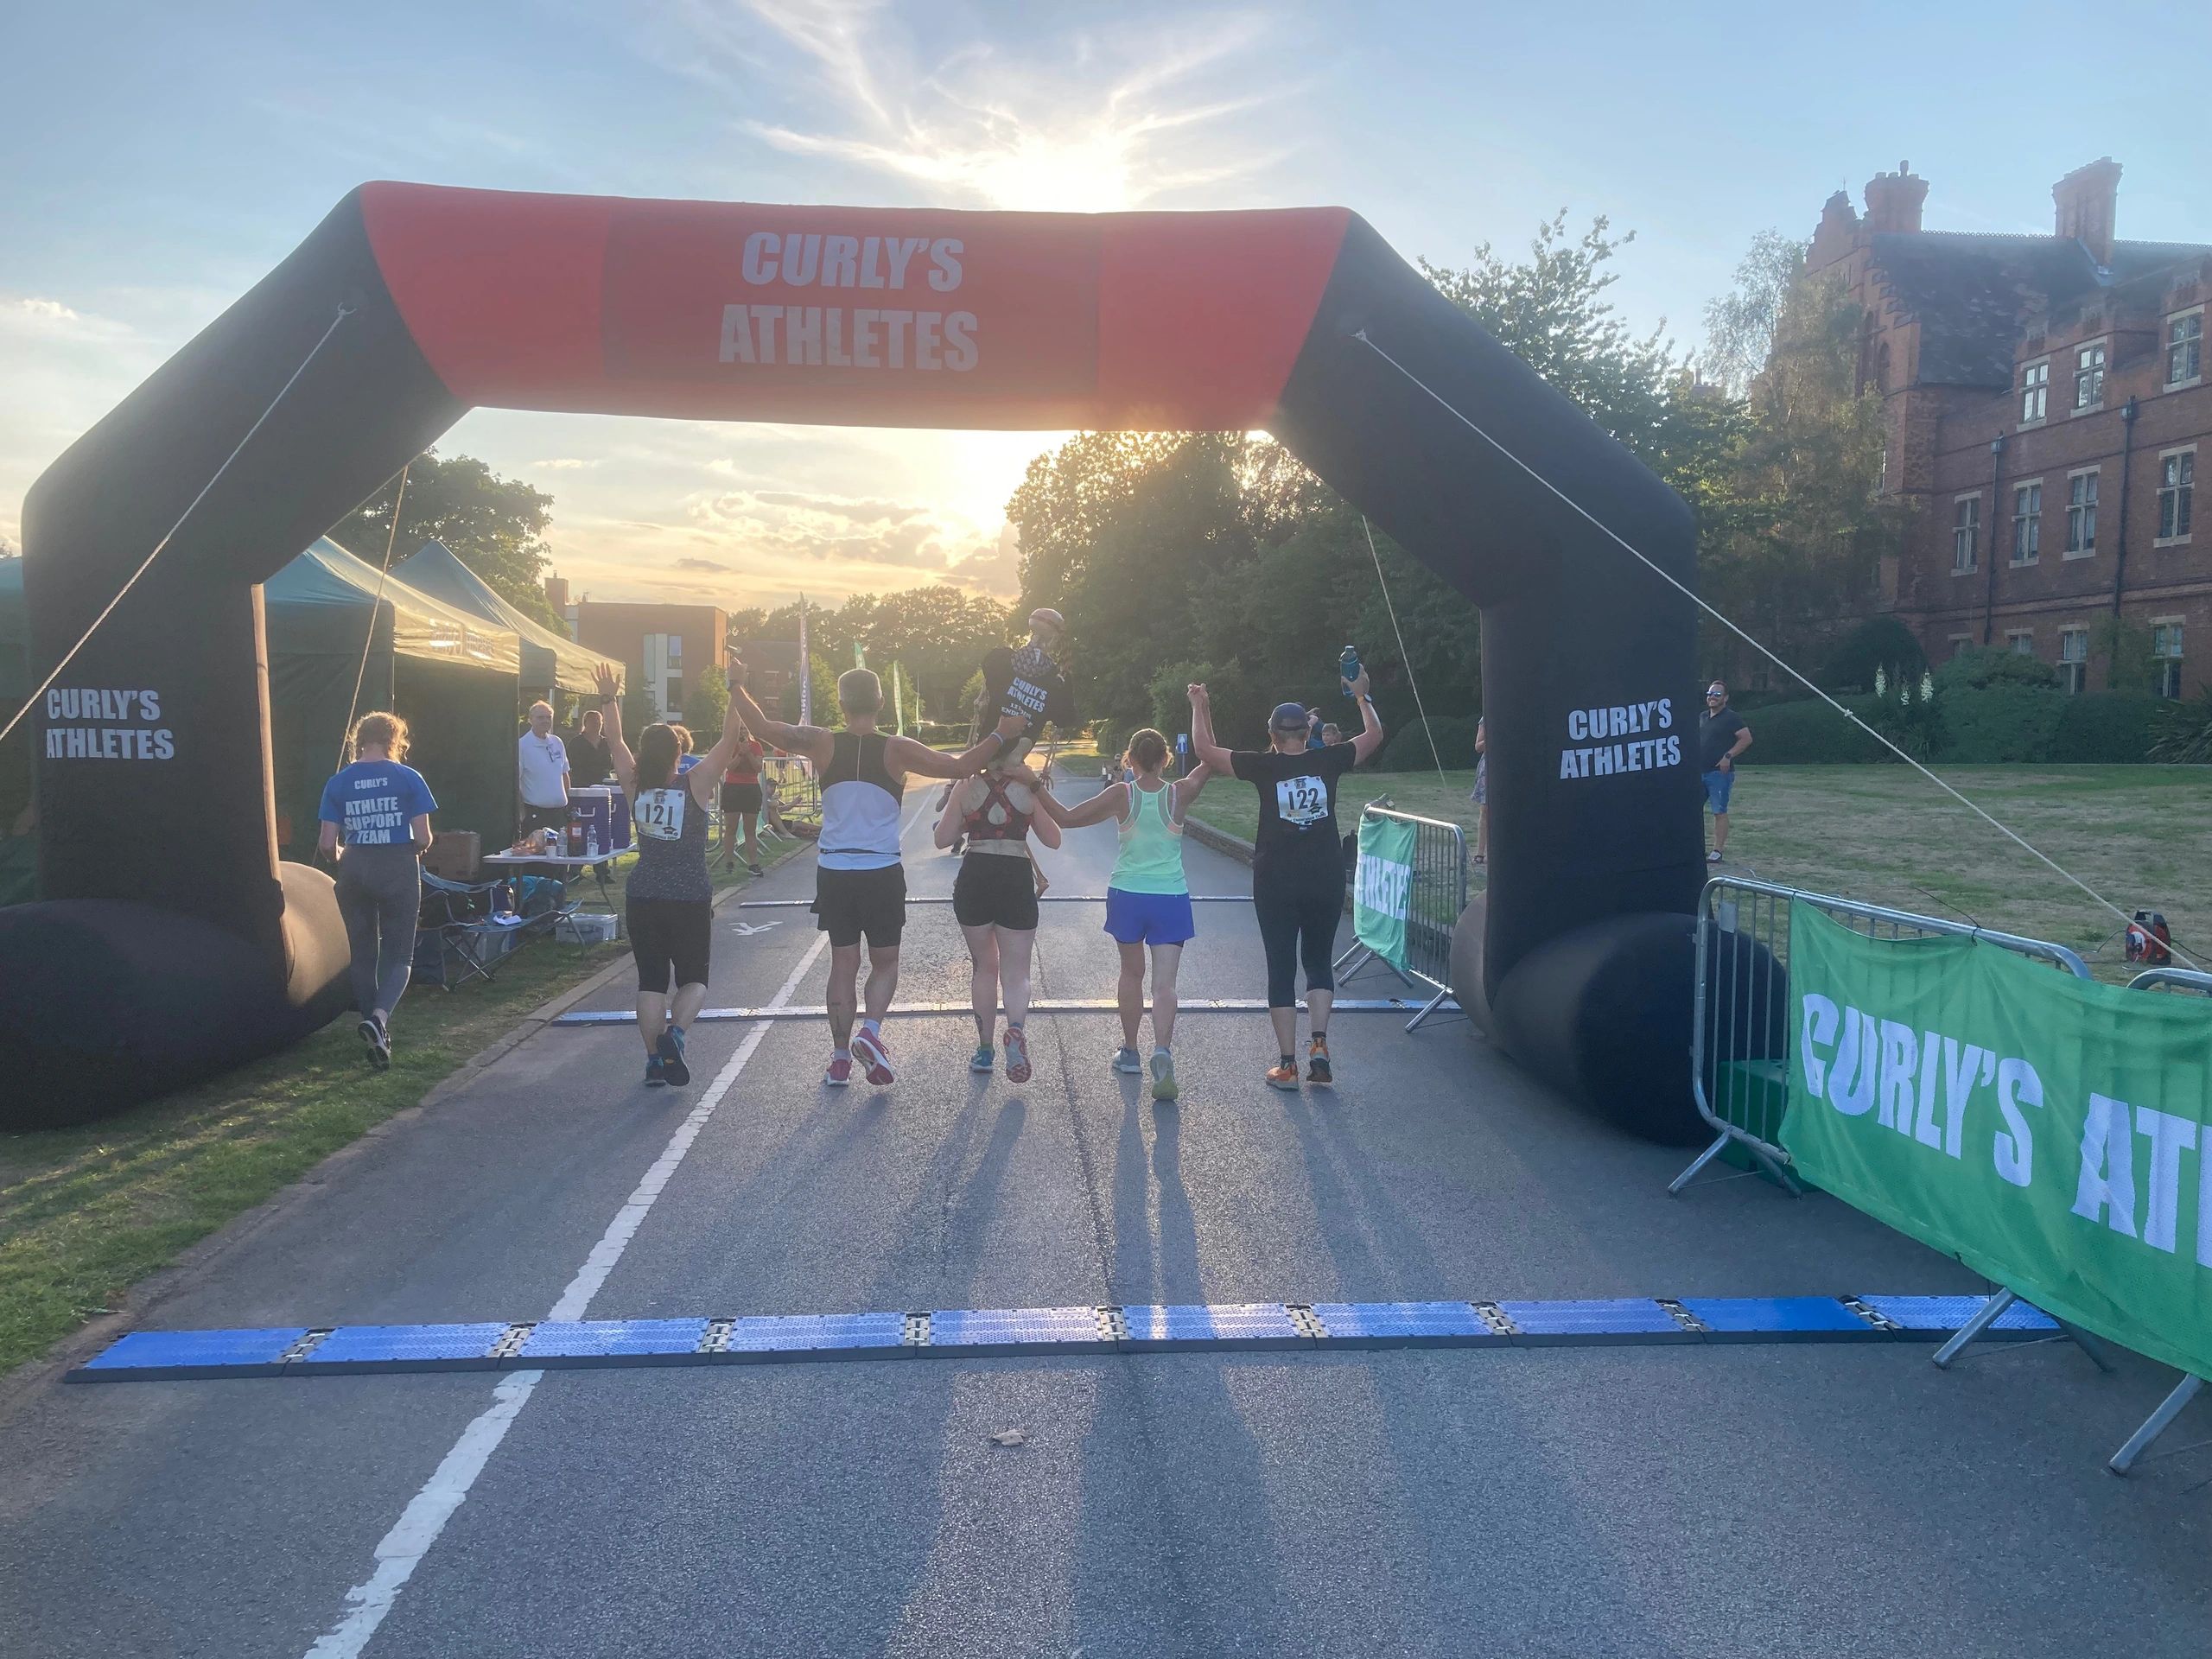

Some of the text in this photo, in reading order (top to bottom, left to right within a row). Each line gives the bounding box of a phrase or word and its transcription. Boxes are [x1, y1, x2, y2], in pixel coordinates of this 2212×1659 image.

[741, 232, 964, 292] CURLY'S
[719, 304, 979, 372] ATHLETES
[1007, 685, 1046, 713] ATHLETES
[1013, 677, 1047, 701] CURLY'S
[47, 689, 161, 721] CURLY'S
[1568, 697, 1672, 741] CURLY'S
[46, 728, 175, 760] ATHLETES
[1560, 734, 1681, 779] ATHLETES
[354, 777, 388, 790] CURLY'S
[346, 797, 398, 816] ATHLETE
[1288, 787, 1319, 810] 122
[344, 812, 404, 831] SUPPORT
[645, 804, 673, 825] 121
[357, 830, 391, 844] TEAM
[1802, 993, 2044, 1187] CURLY'S
